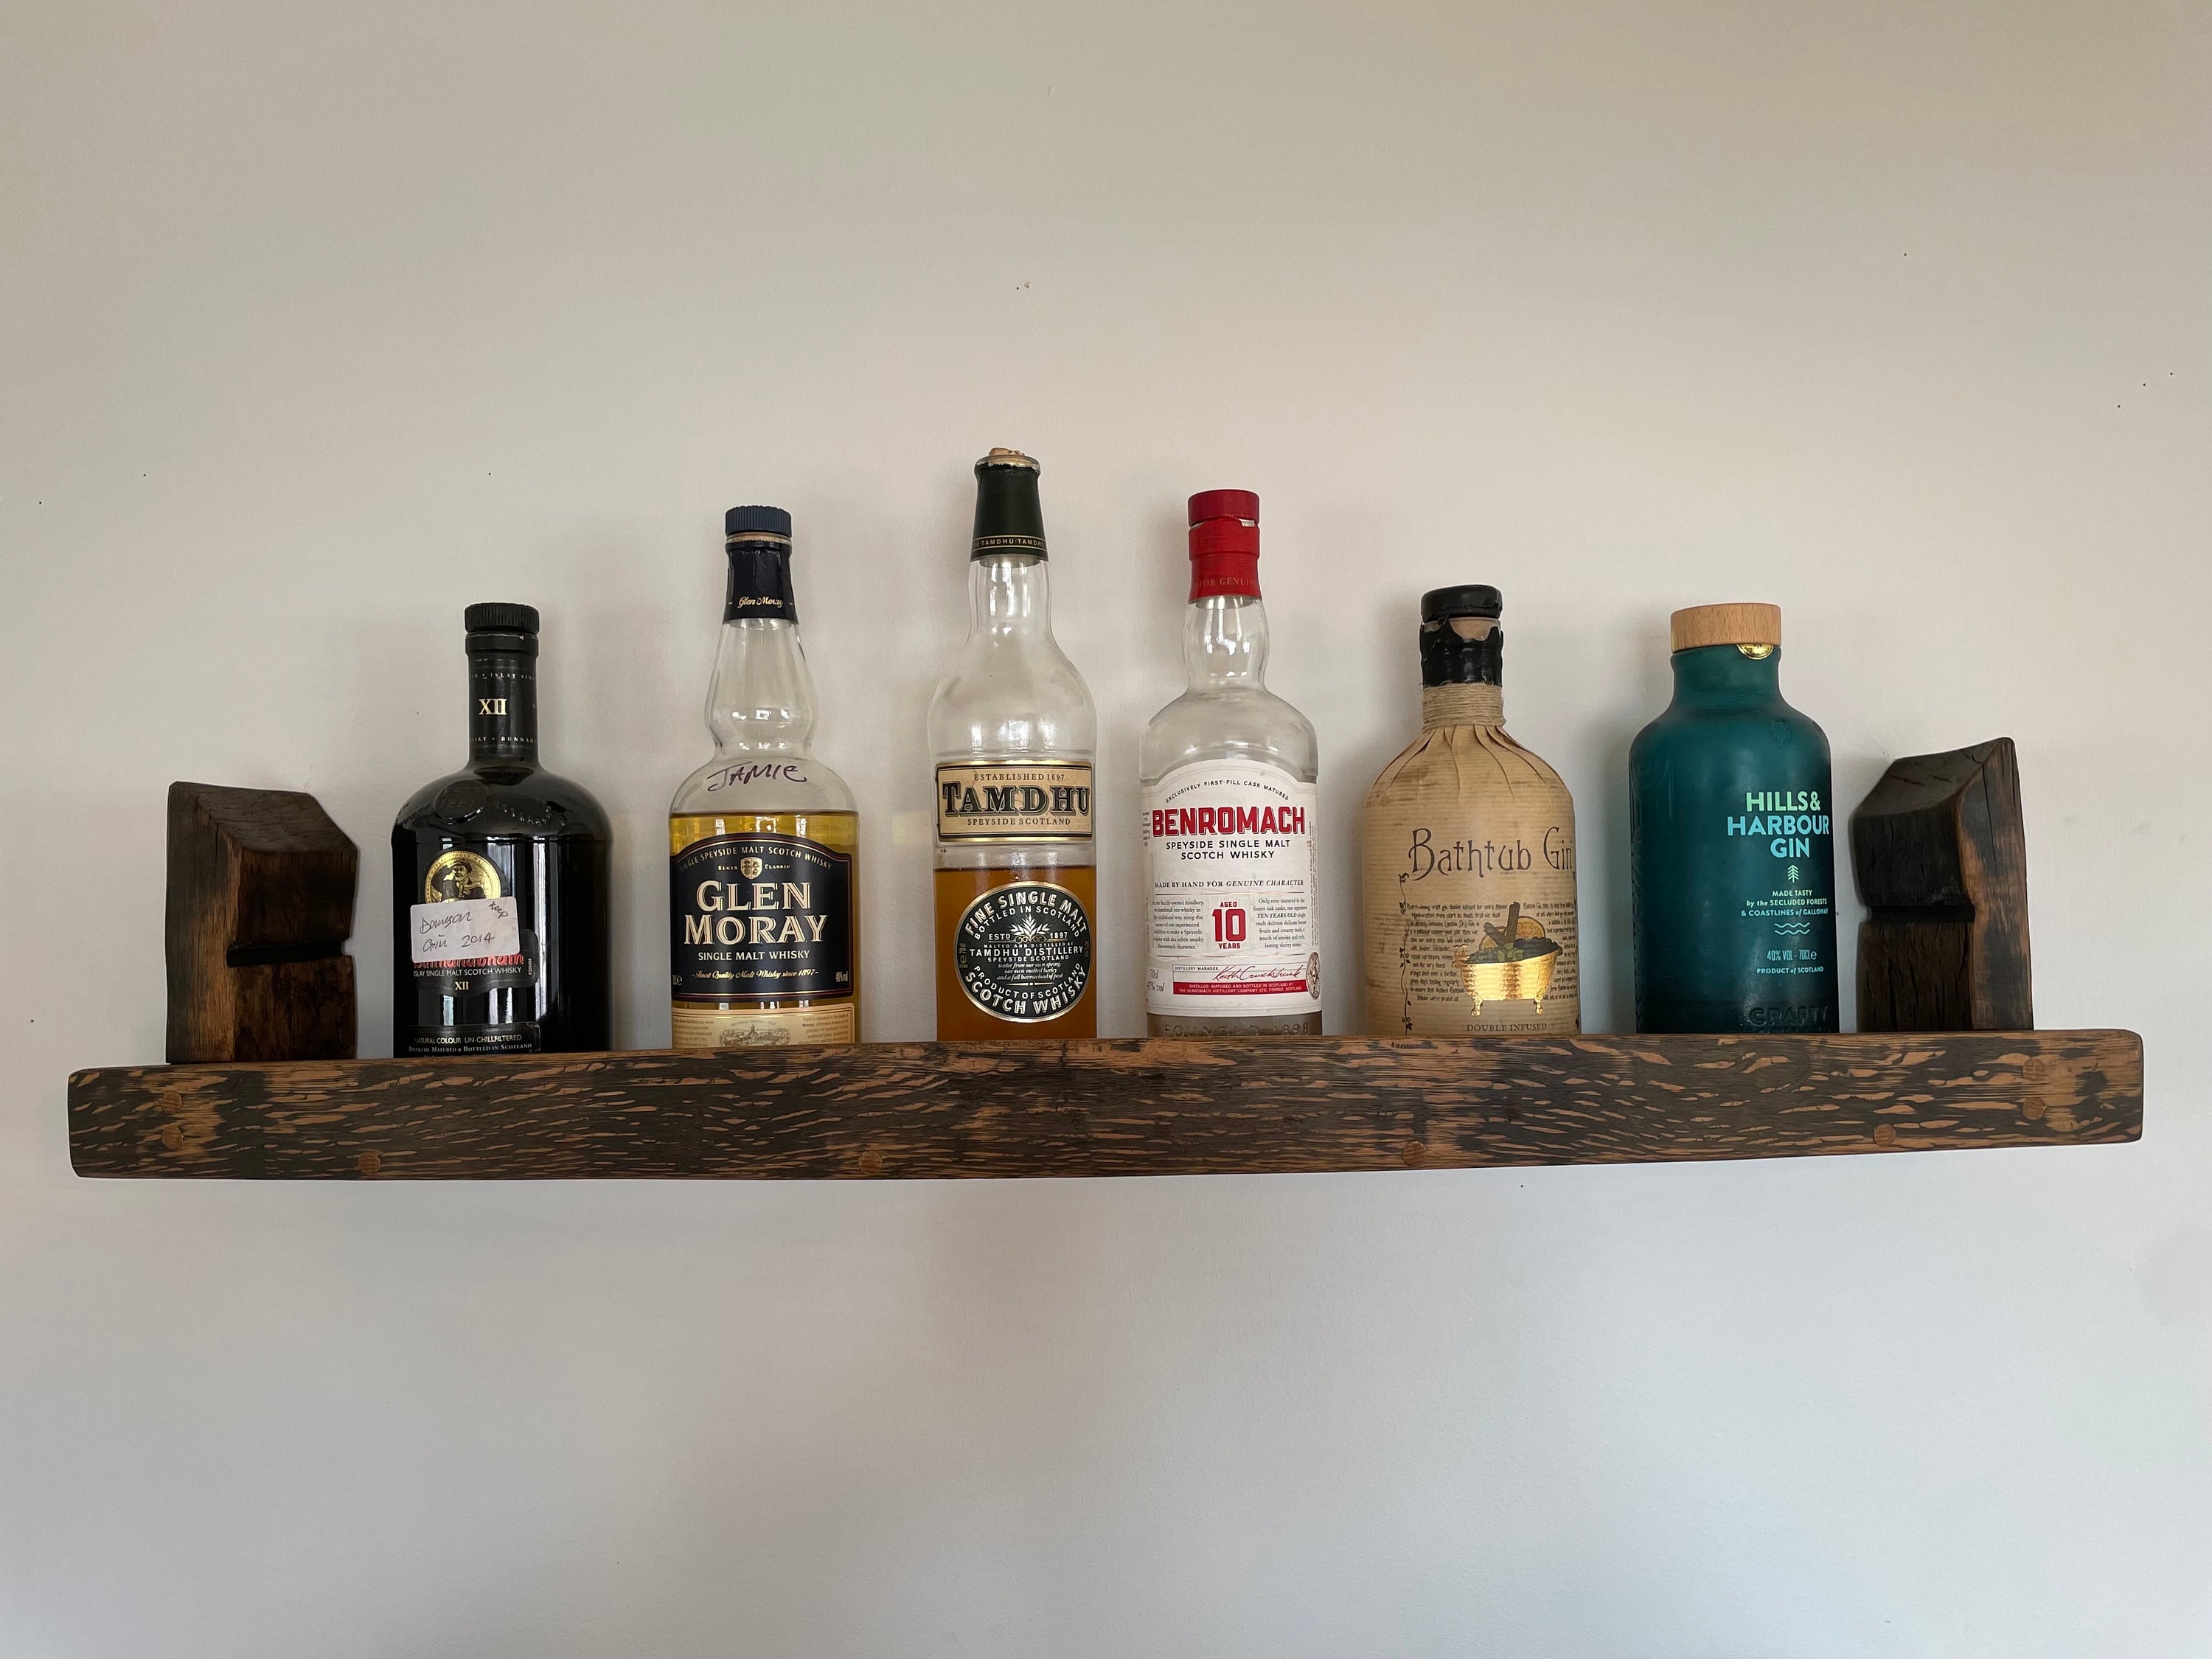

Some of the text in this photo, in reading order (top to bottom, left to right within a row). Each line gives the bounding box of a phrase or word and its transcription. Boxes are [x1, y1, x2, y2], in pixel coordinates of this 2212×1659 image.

[1220, 577, 1256, 586] GENUIN
[478, 698, 507, 715] XII
[707, 761, 808, 793] JAMIE
[974, 773, 1065, 782] ESTABLISHED 1897
[942, 781, 1091, 818] TAMDHU
[1166, 783, 1201, 804] EXCLUSIVELY
[1244, 780, 1261, 788] CASK
[1264, 785, 1290, 801] MATURED
[967, 818, 1071, 826] SPEYSIDE SCOTLAND
[1152, 806, 1306, 838] BENROMACH
[1727, 815, 1830, 836] HARBOUR
[1166, 839, 1290, 849] SPEYSIDE SINGLE MALT
[1770, 838, 1810, 858] GIN
[679, 846, 832, 873] SINGLE SPEYSIDE MALT SCOTCH WHISKY
[1180, 850, 1275, 860] SCOTCH WHISKY
[1408, 826, 1573, 882] Bathtub Gin
[696, 880, 813, 912] GLEN
[1746, 900, 1755, 908] by
[965, 891, 1088, 936] FINE SINGLE MALT
[1795, 909, 1802, 917] of
[684, 914, 829, 946] MORAY
[974, 905, 1079, 940] BOTTLED IN SCOTLAND
[1211, 908, 1246, 942] 10
[422, 932, 495, 953] Gin 2014
[1049, 931, 1068, 939] 1897
[698, 950, 810, 961] SINGLE MALT WHISKY
[970, 948, 1019, 957] TAMDHU
[1025, 946, 1083, 956] DISTILLERY
[1767, 950, 1781, 961] 40%
[1782, 949, 1794, 961] VOL
[413, 970, 425, 978] ISLAY
[464, 967, 493, 975] SCOTCH
[712, 970, 734, 981] Quality
[756, 970, 782, 980] Whisky
[455, 981, 470, 991] XII
[974, 963, 1080, 1000] PRODUCT OF SCOTLAND
[965, 967, 1087, 1015] SCOTCH WHISKY
[1467, 1023, 1547, 1032] DOUBLE INFUSED
[464, 1034, 523, 1043] UN-CHILLFILTERED
